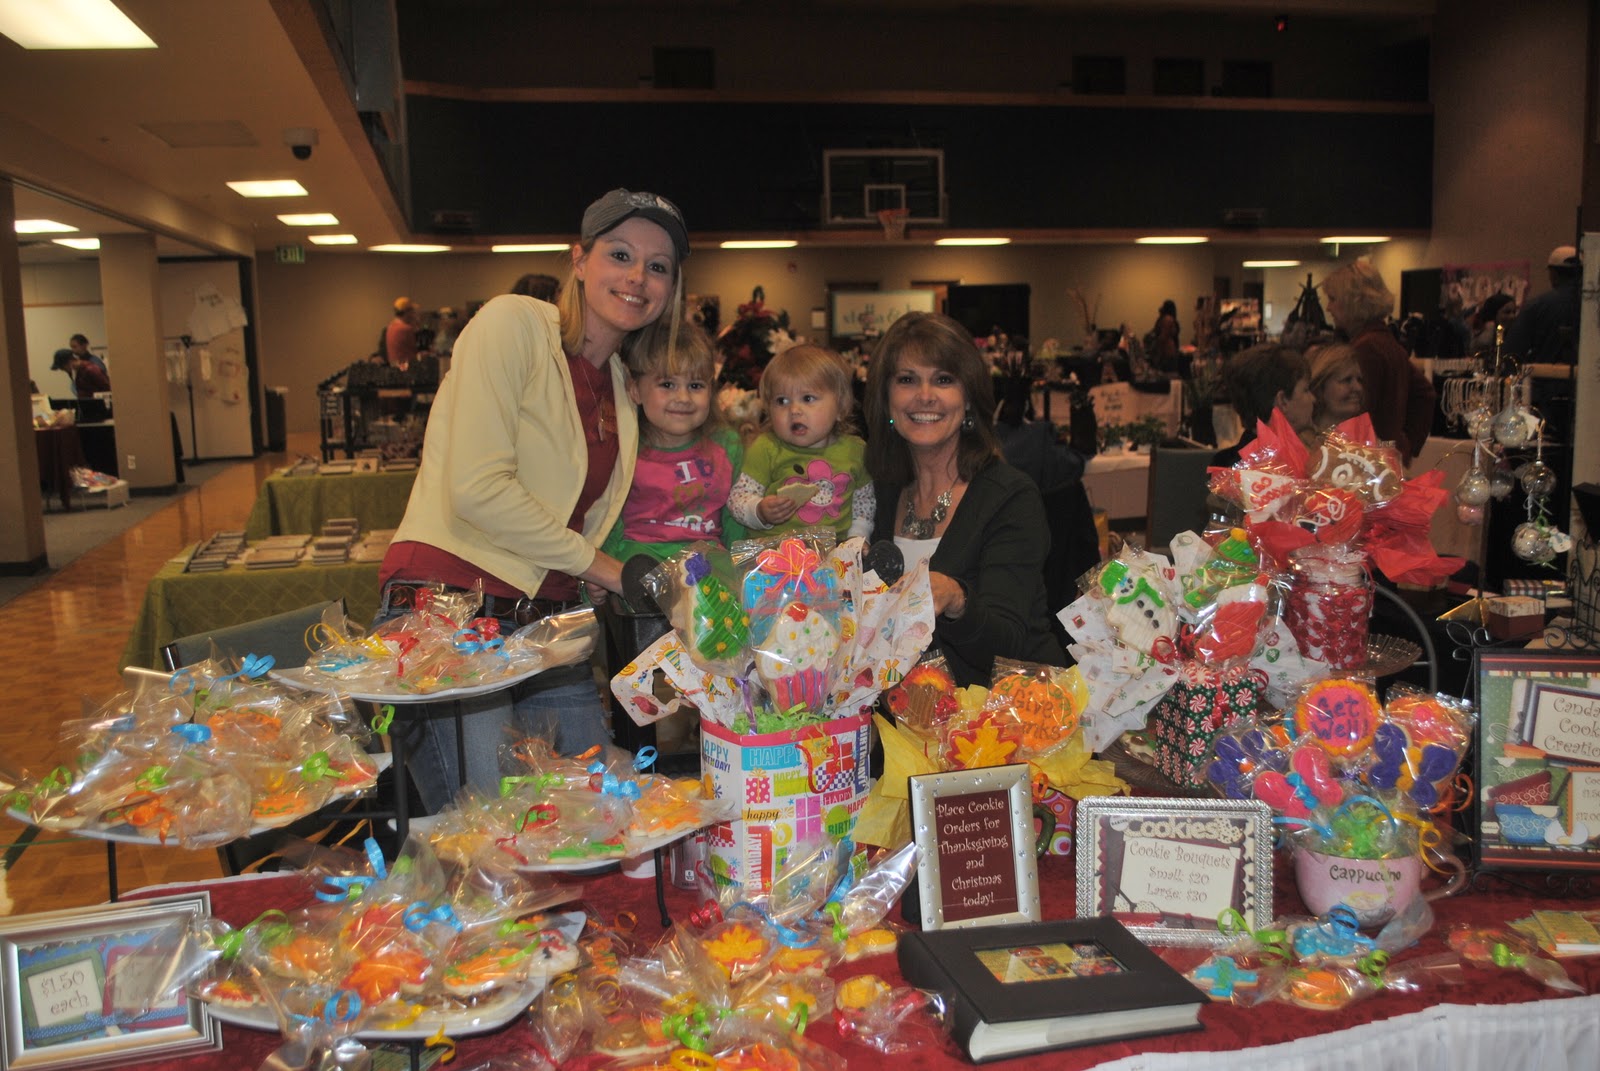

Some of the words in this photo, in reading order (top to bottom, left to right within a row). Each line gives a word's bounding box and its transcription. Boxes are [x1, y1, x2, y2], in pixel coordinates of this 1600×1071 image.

[747, 808, 779, 822] happy
[936, 803, 965, 817] Place
[968, 797, 1005, 813] Cookie
[943, 821, 981, 835] Orders
[984, 817, 1001, 830] for
[938, 834, 1009, 854] Thanksgiving
[966, 855, 985, 870] and
[1130, 840, 1171, 860] Cookie
[1175, 845, 1231, 869] Bouquets
[951, 873, 1002, 891] Christmas
[1149, 865, 1184, 883] Small:
[1188, 872, 1210, 886] $20
[963, 892, 994, 908] today!
[1146, 884, 1183, 900] Large:
[1187, 888, 1208, 904] $30
[41, 970, 85, 998] $1.50
[51, 990, 89, 1015] each
